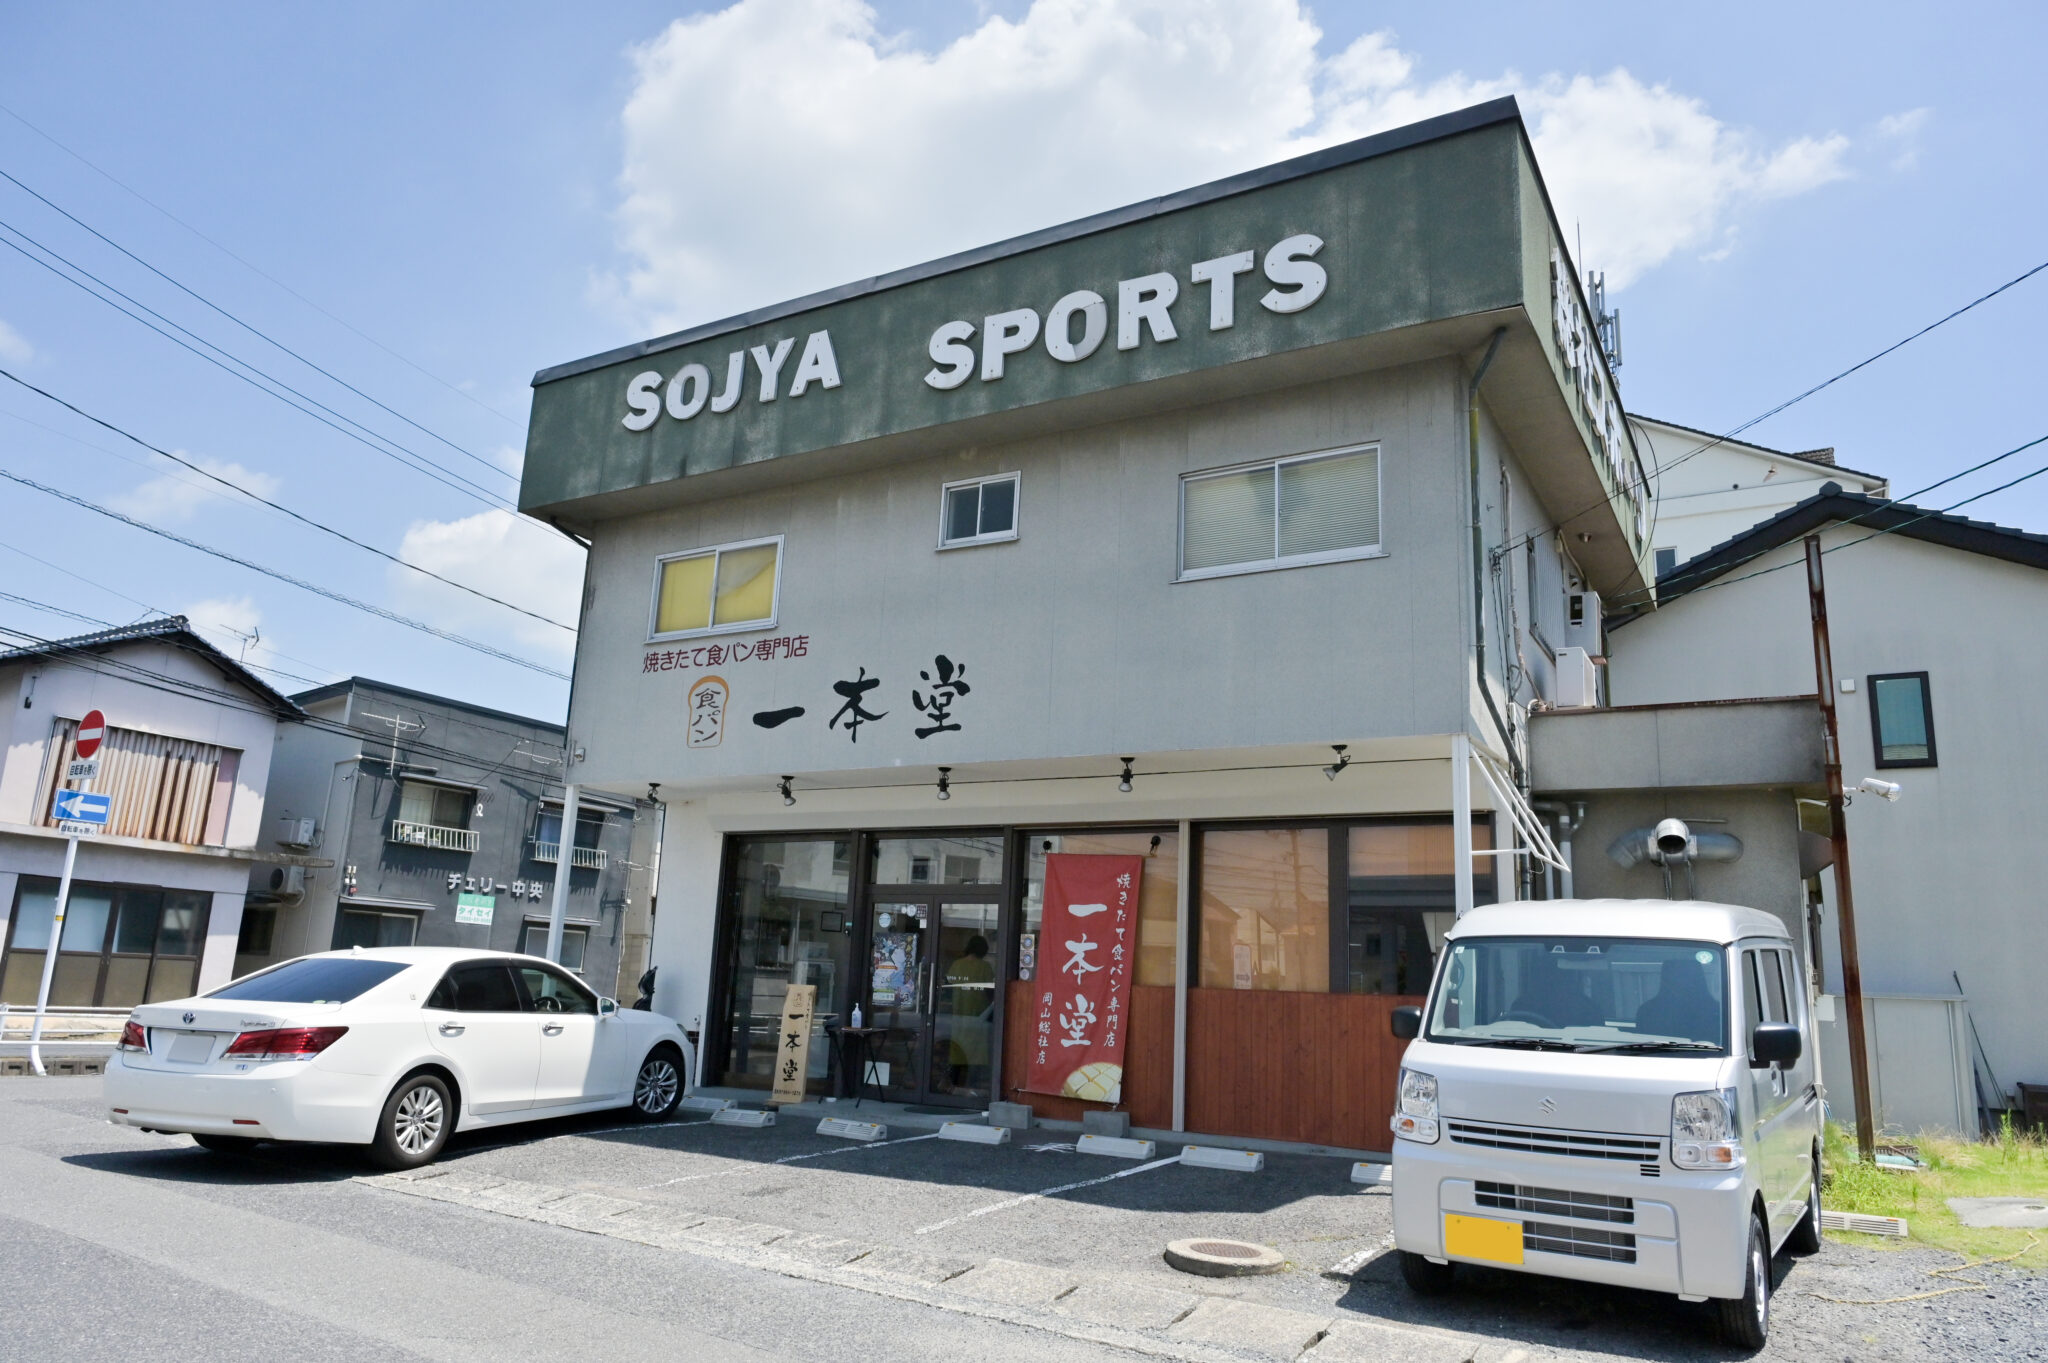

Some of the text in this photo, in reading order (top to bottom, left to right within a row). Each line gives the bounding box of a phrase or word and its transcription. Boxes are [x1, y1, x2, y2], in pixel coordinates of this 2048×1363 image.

[622, 233, 1329, 432] SOJYA SPORTS
[642, 634, 810, 675] 焼きたて食パン専門店
[691, 687, 722, 743] 食パン
[752, 654, 972, 743] 一本堂
[447, 873, 544, 899] チェリー中央
[458, 907, 492, 918] タイセイ
[1059, 903, 1108, 1048] 一本堂
[1103, 872, 1132, 1048] 焼きたて食パン専門店
[783, 1013, 805, 1082] 一本堂
[1036, 991, 1053, 1065] 岡山総社店
